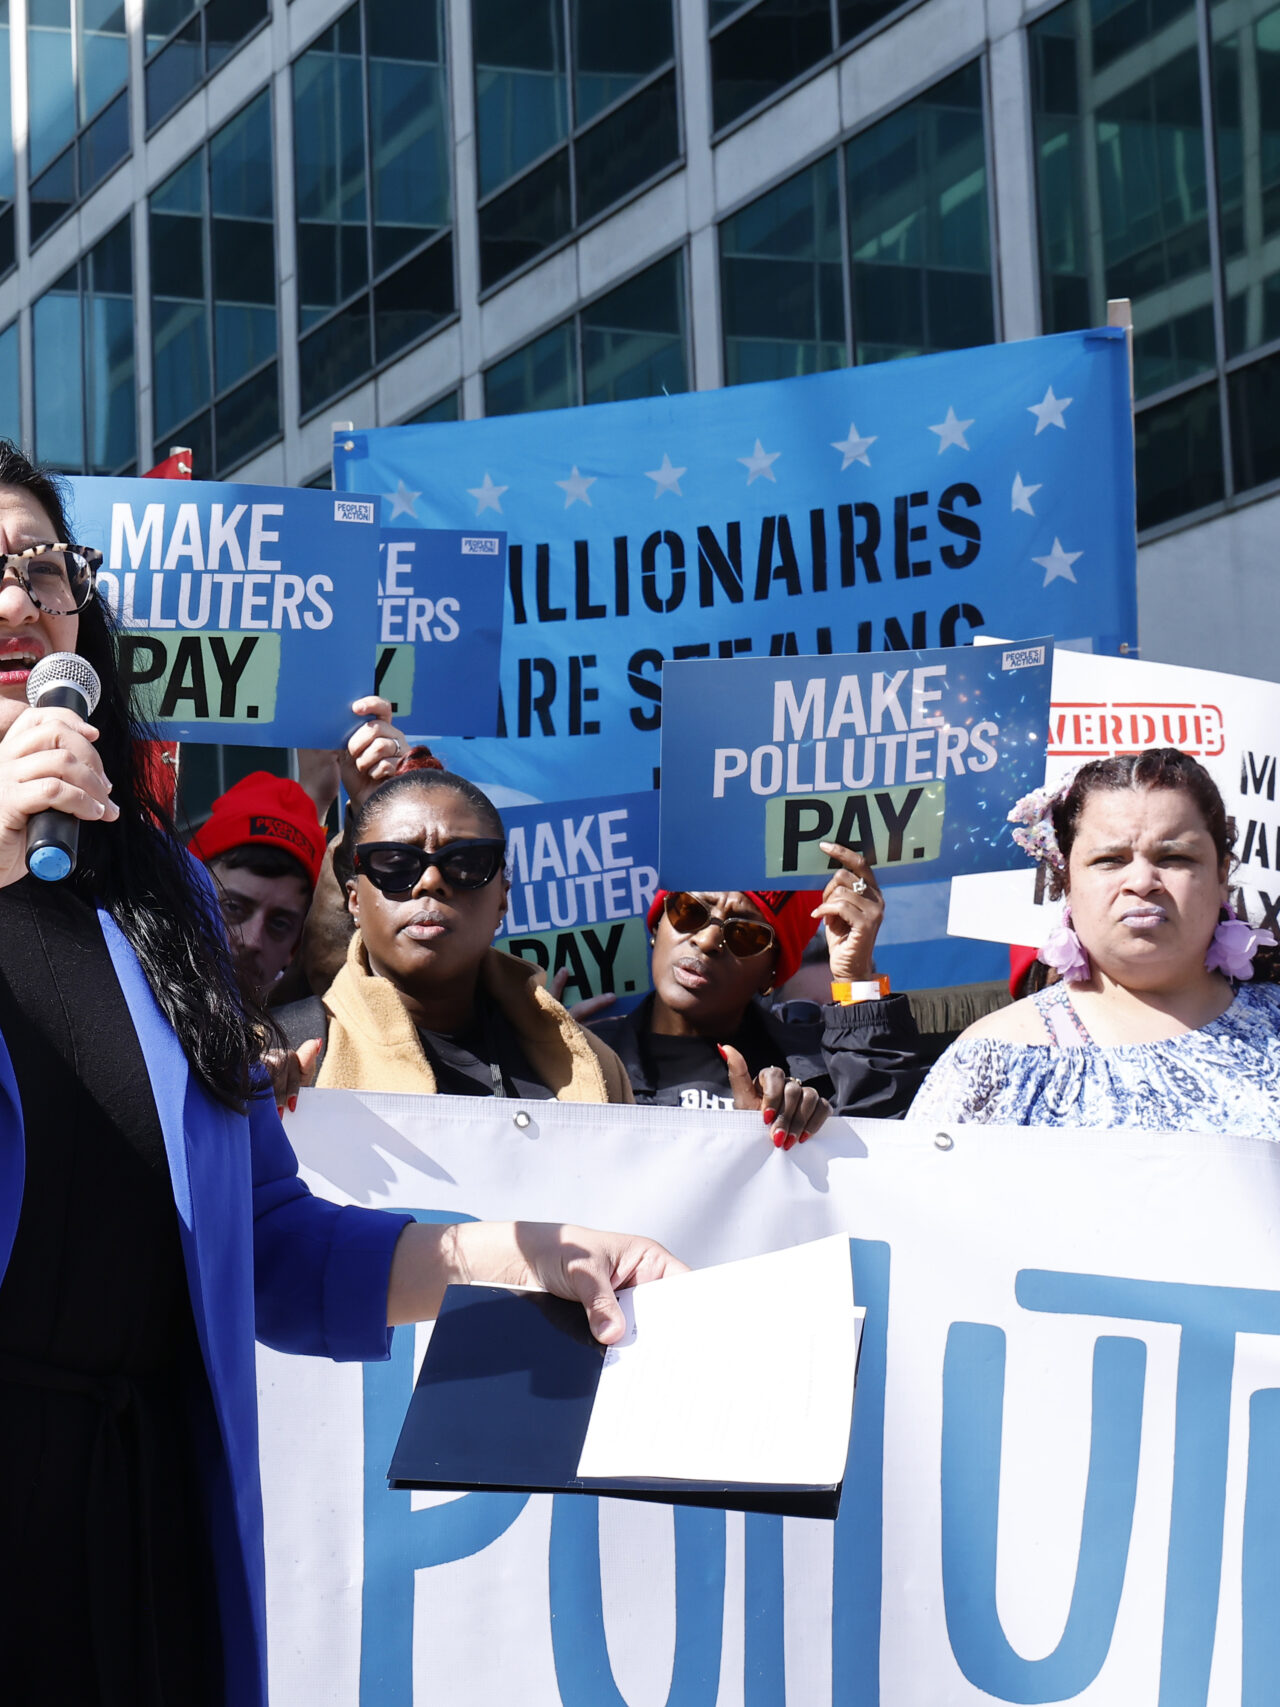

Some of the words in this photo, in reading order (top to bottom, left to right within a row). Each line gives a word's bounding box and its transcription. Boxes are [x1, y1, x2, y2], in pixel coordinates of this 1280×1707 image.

[109, 503, 284, 572] MAKE
[96, 572, 334, 631] OLLUTERS
[377, 597, 461, 643] ERS
[120, 636, 260, 719] PAY.
[772, 664, 947, 742] MAKE
[713, 721, 1000, 799] POLLUTERS
[1047, 714, 1216, 745] VERDUE
[504, 809, 634, 884] MAKE
[781, 787, 925, 873] PAY.
[495, 865, 659, 936] LLUTER
